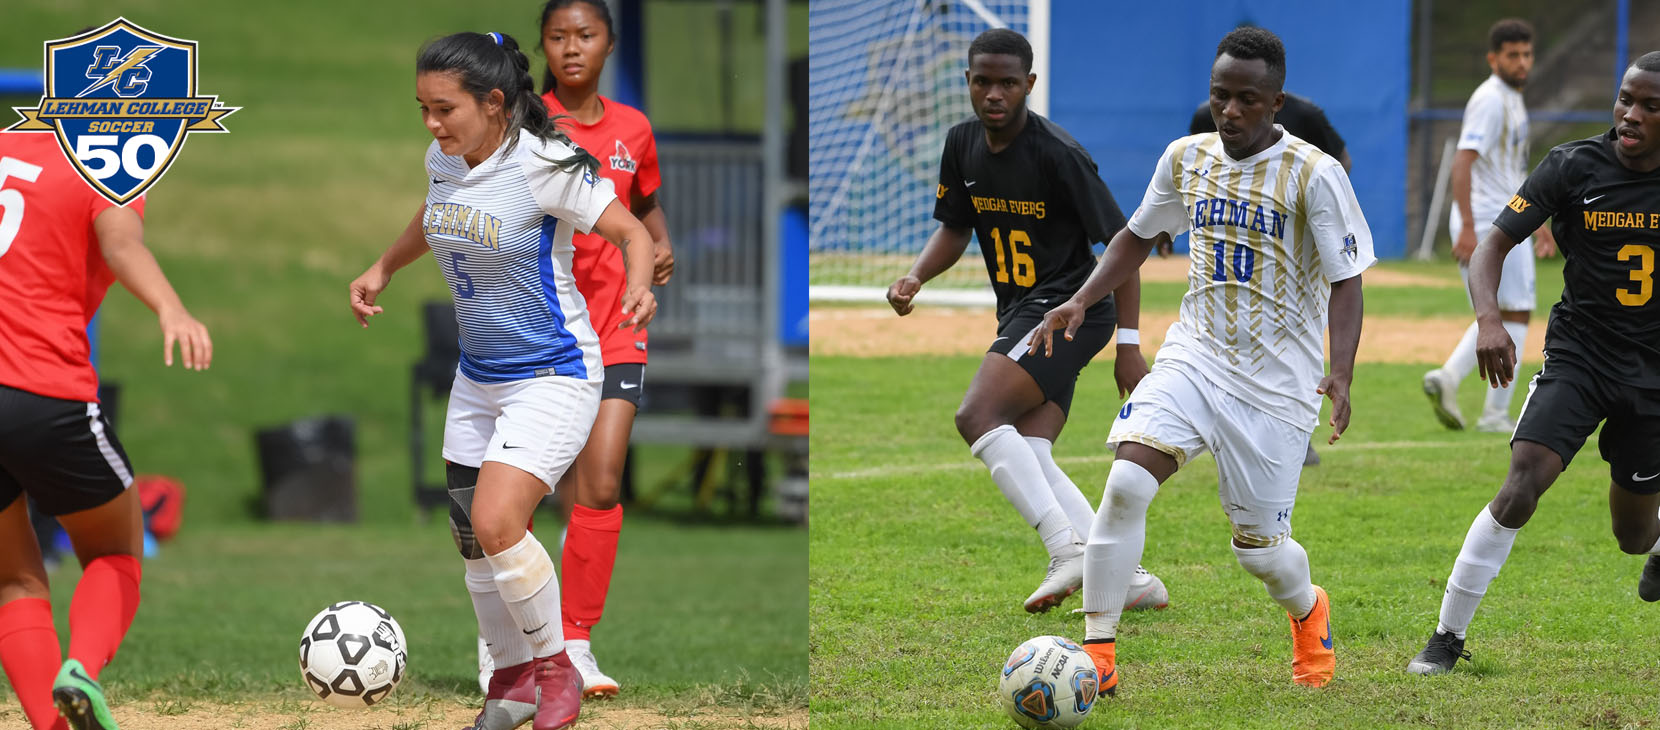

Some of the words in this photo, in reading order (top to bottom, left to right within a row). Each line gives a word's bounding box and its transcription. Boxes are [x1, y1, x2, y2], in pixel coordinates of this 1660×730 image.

[610, 157, 636, 171] YORK
[970, 195, 1009, 214] MEDGAR
[1008, 200, 1046, 219] EVERS
[1583, 210, 1645, 231] MEDGAR
[423, 202, 503, 251] EHMAN
[450, 251, 475, 299] 5
[990, 227, 1037, 288] 16
[1212, 239, 1255, 283] 10
[1615, 244, 1655, 307] 3
[1034, 647, 1055, 675] Wilson
[1051, 654, 1070, 680] NCAA
